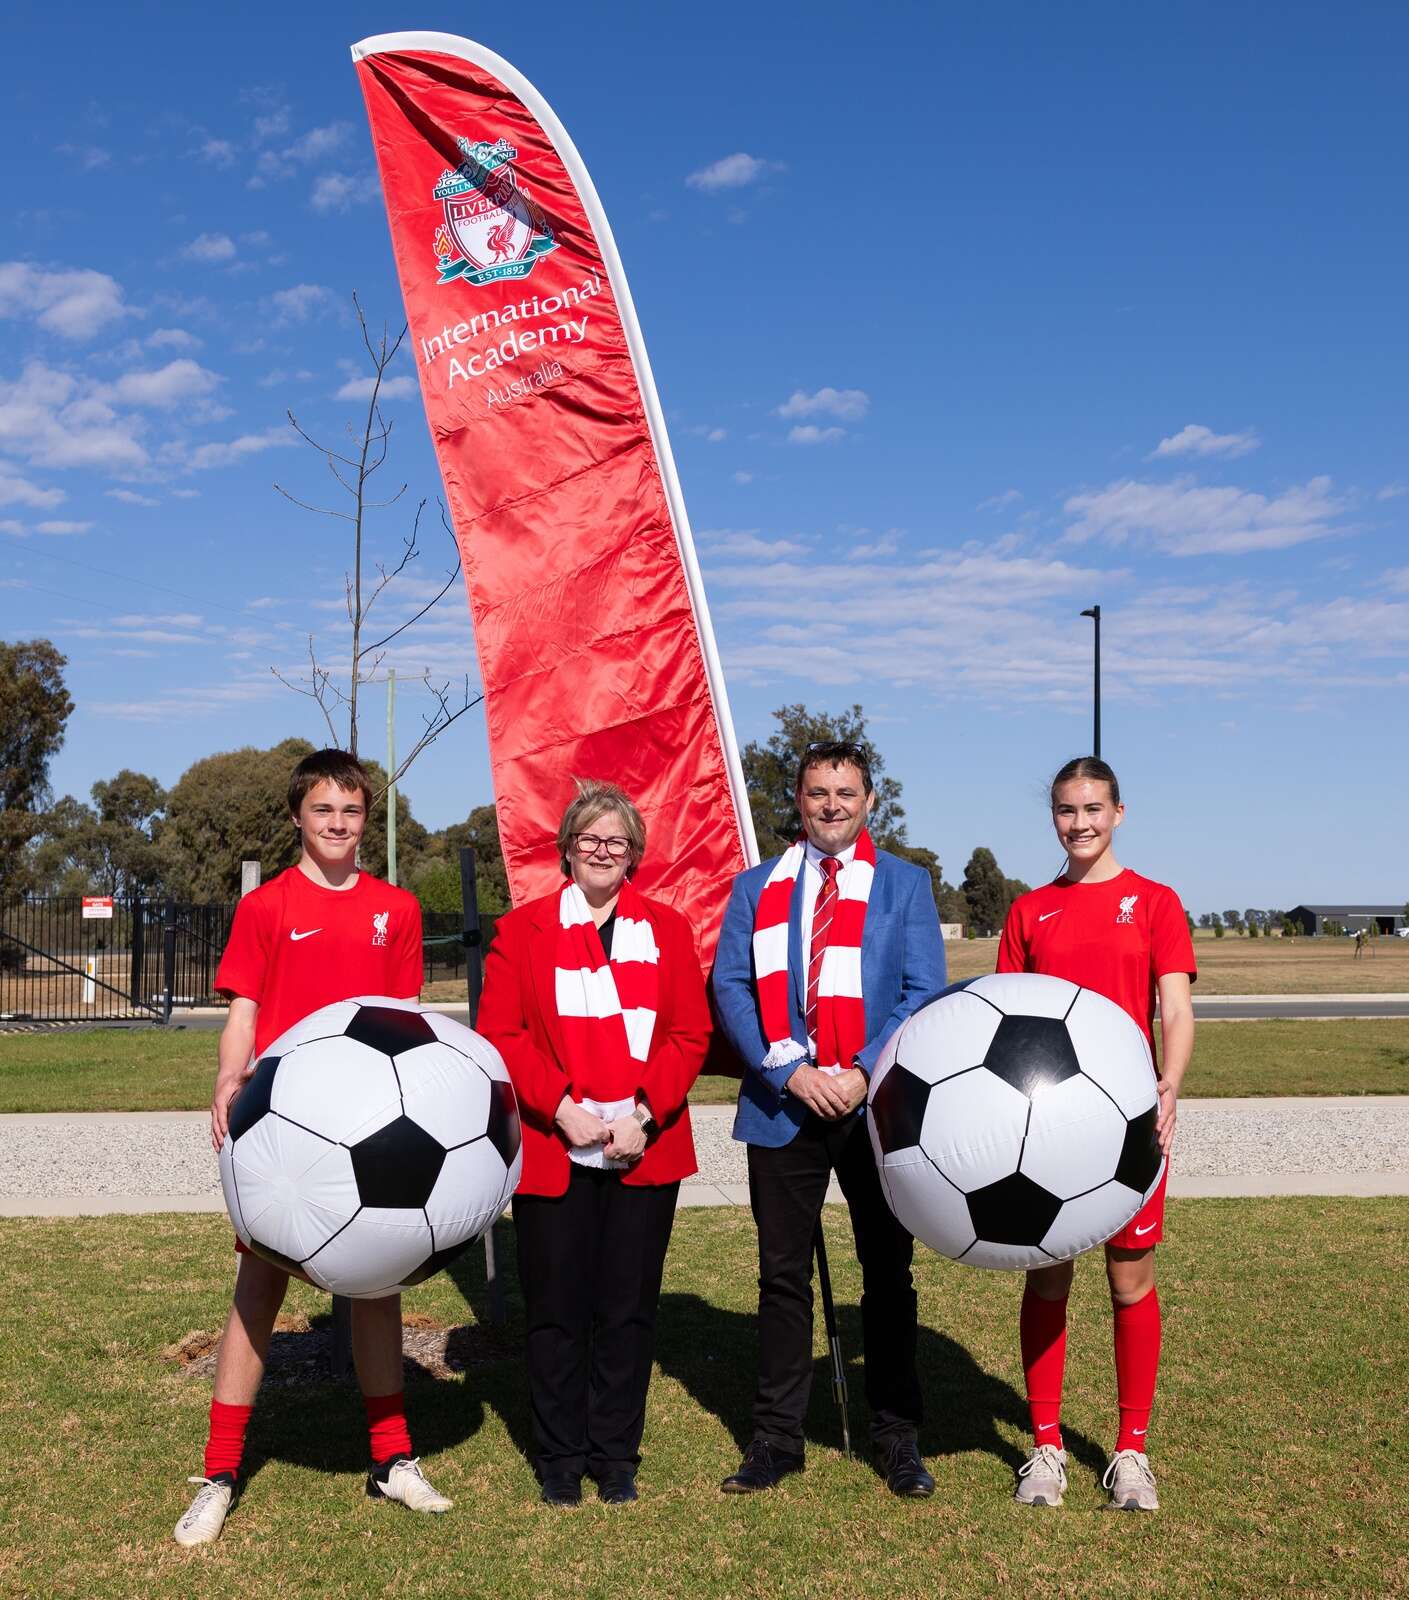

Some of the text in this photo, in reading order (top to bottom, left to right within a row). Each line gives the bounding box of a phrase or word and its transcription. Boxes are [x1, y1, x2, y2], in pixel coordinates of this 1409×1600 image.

[458, 208, 505, 227] FOOTBALL
[421, 266, 601, 365] International
[448, 315, 588, 389] Academy
[487, 360, 563, 409] Australia
[1116, 916, 1134, 924] LFC
[372, 937, 387, 946] LFC
